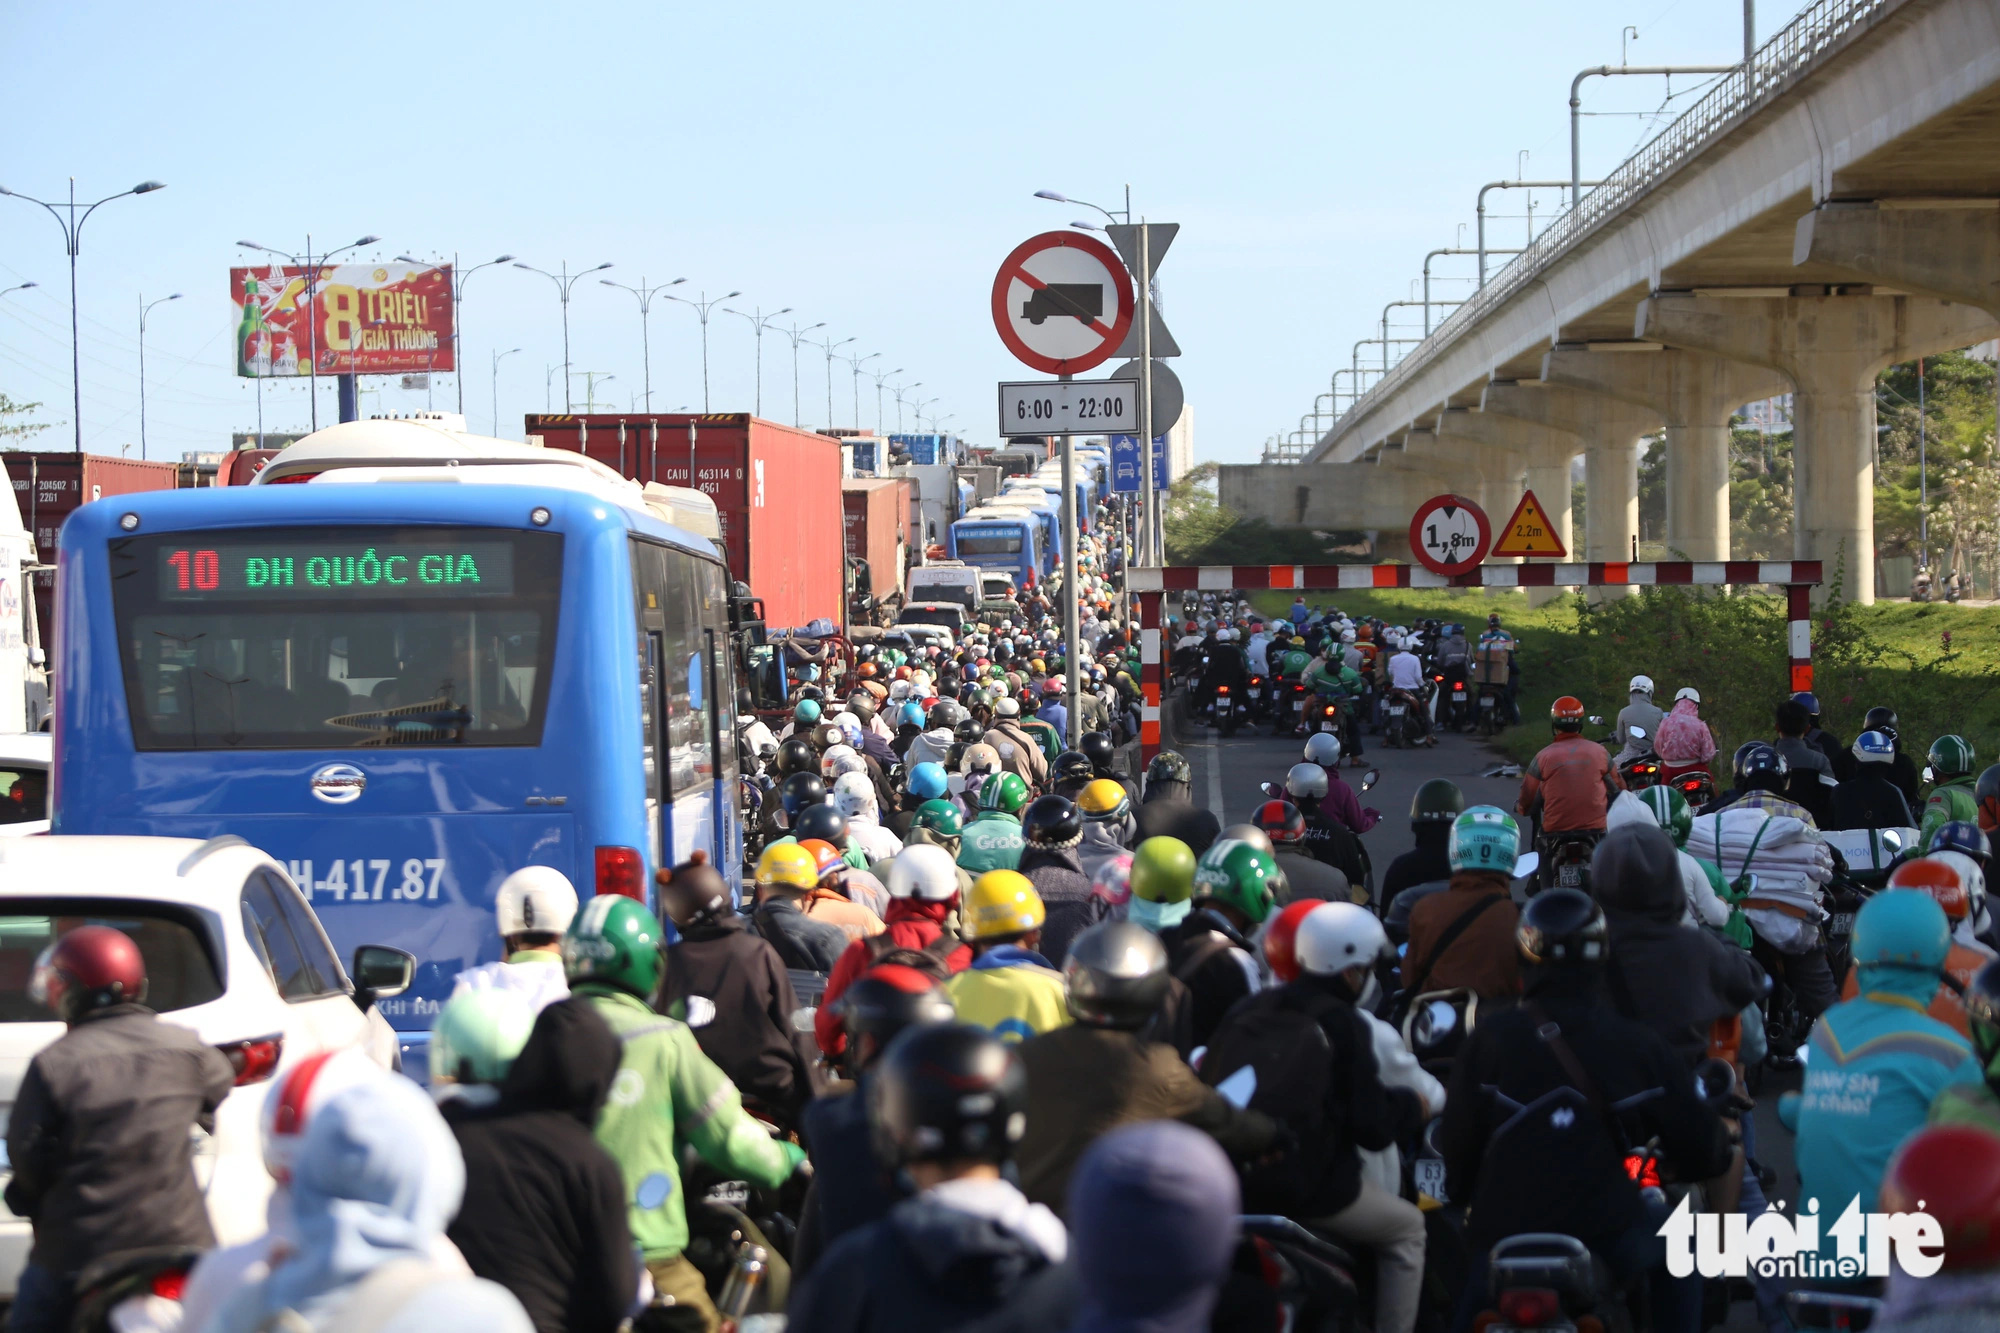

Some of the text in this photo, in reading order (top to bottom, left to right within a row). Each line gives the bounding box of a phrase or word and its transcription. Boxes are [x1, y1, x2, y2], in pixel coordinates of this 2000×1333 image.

[324, 283, 363, 351] 8
[361, 287, 428, 331] TRIỆU
[1017, 398, 1053, 419] 6:00
[1078, 397, 1123, 418] 22:00
[667, 468, 688, 479] CAIU
[699, 468, 730, 479] 463114
[39, 480, 67, 490] 204502
[699, 482, 719, 493] 45G1
[1427, 524, 1475, 553] 1,8m
[167, 550, 220, 591] 10
[244, 548, 481, 588] ĐH QUỐC GIA
[976, 834, 1024, 850] Grab
[1425, 1163, 1442, 1180] 63
